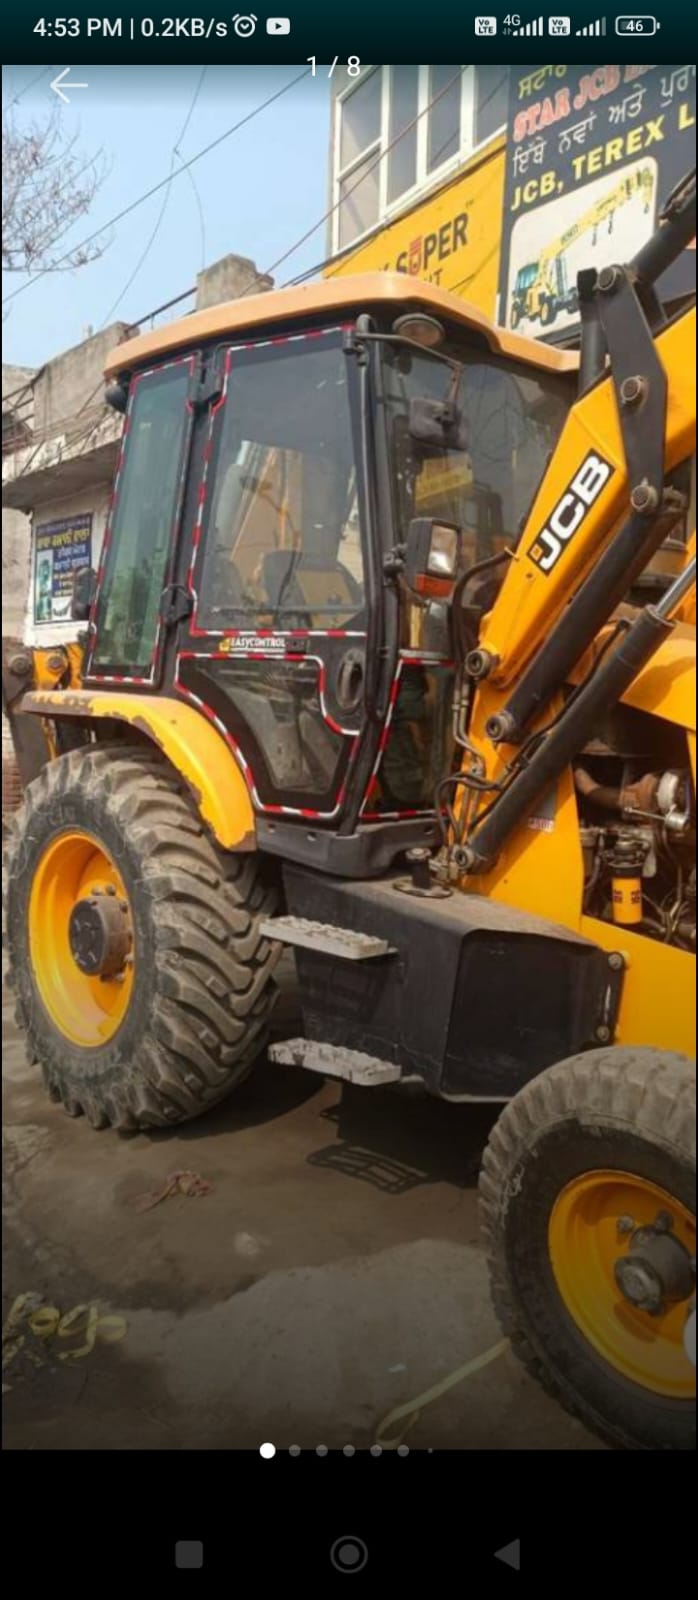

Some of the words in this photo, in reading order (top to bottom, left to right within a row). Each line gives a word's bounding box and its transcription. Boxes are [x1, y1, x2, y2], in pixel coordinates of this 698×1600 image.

[512, 87, 571, 143] STAR
[608, 83, 647, 124] ਅਤੇ
[572, 115, 665, 181] TEREX
[396, 212, 468, 276] SUPER
[539, 456, 610, 570] JCB
